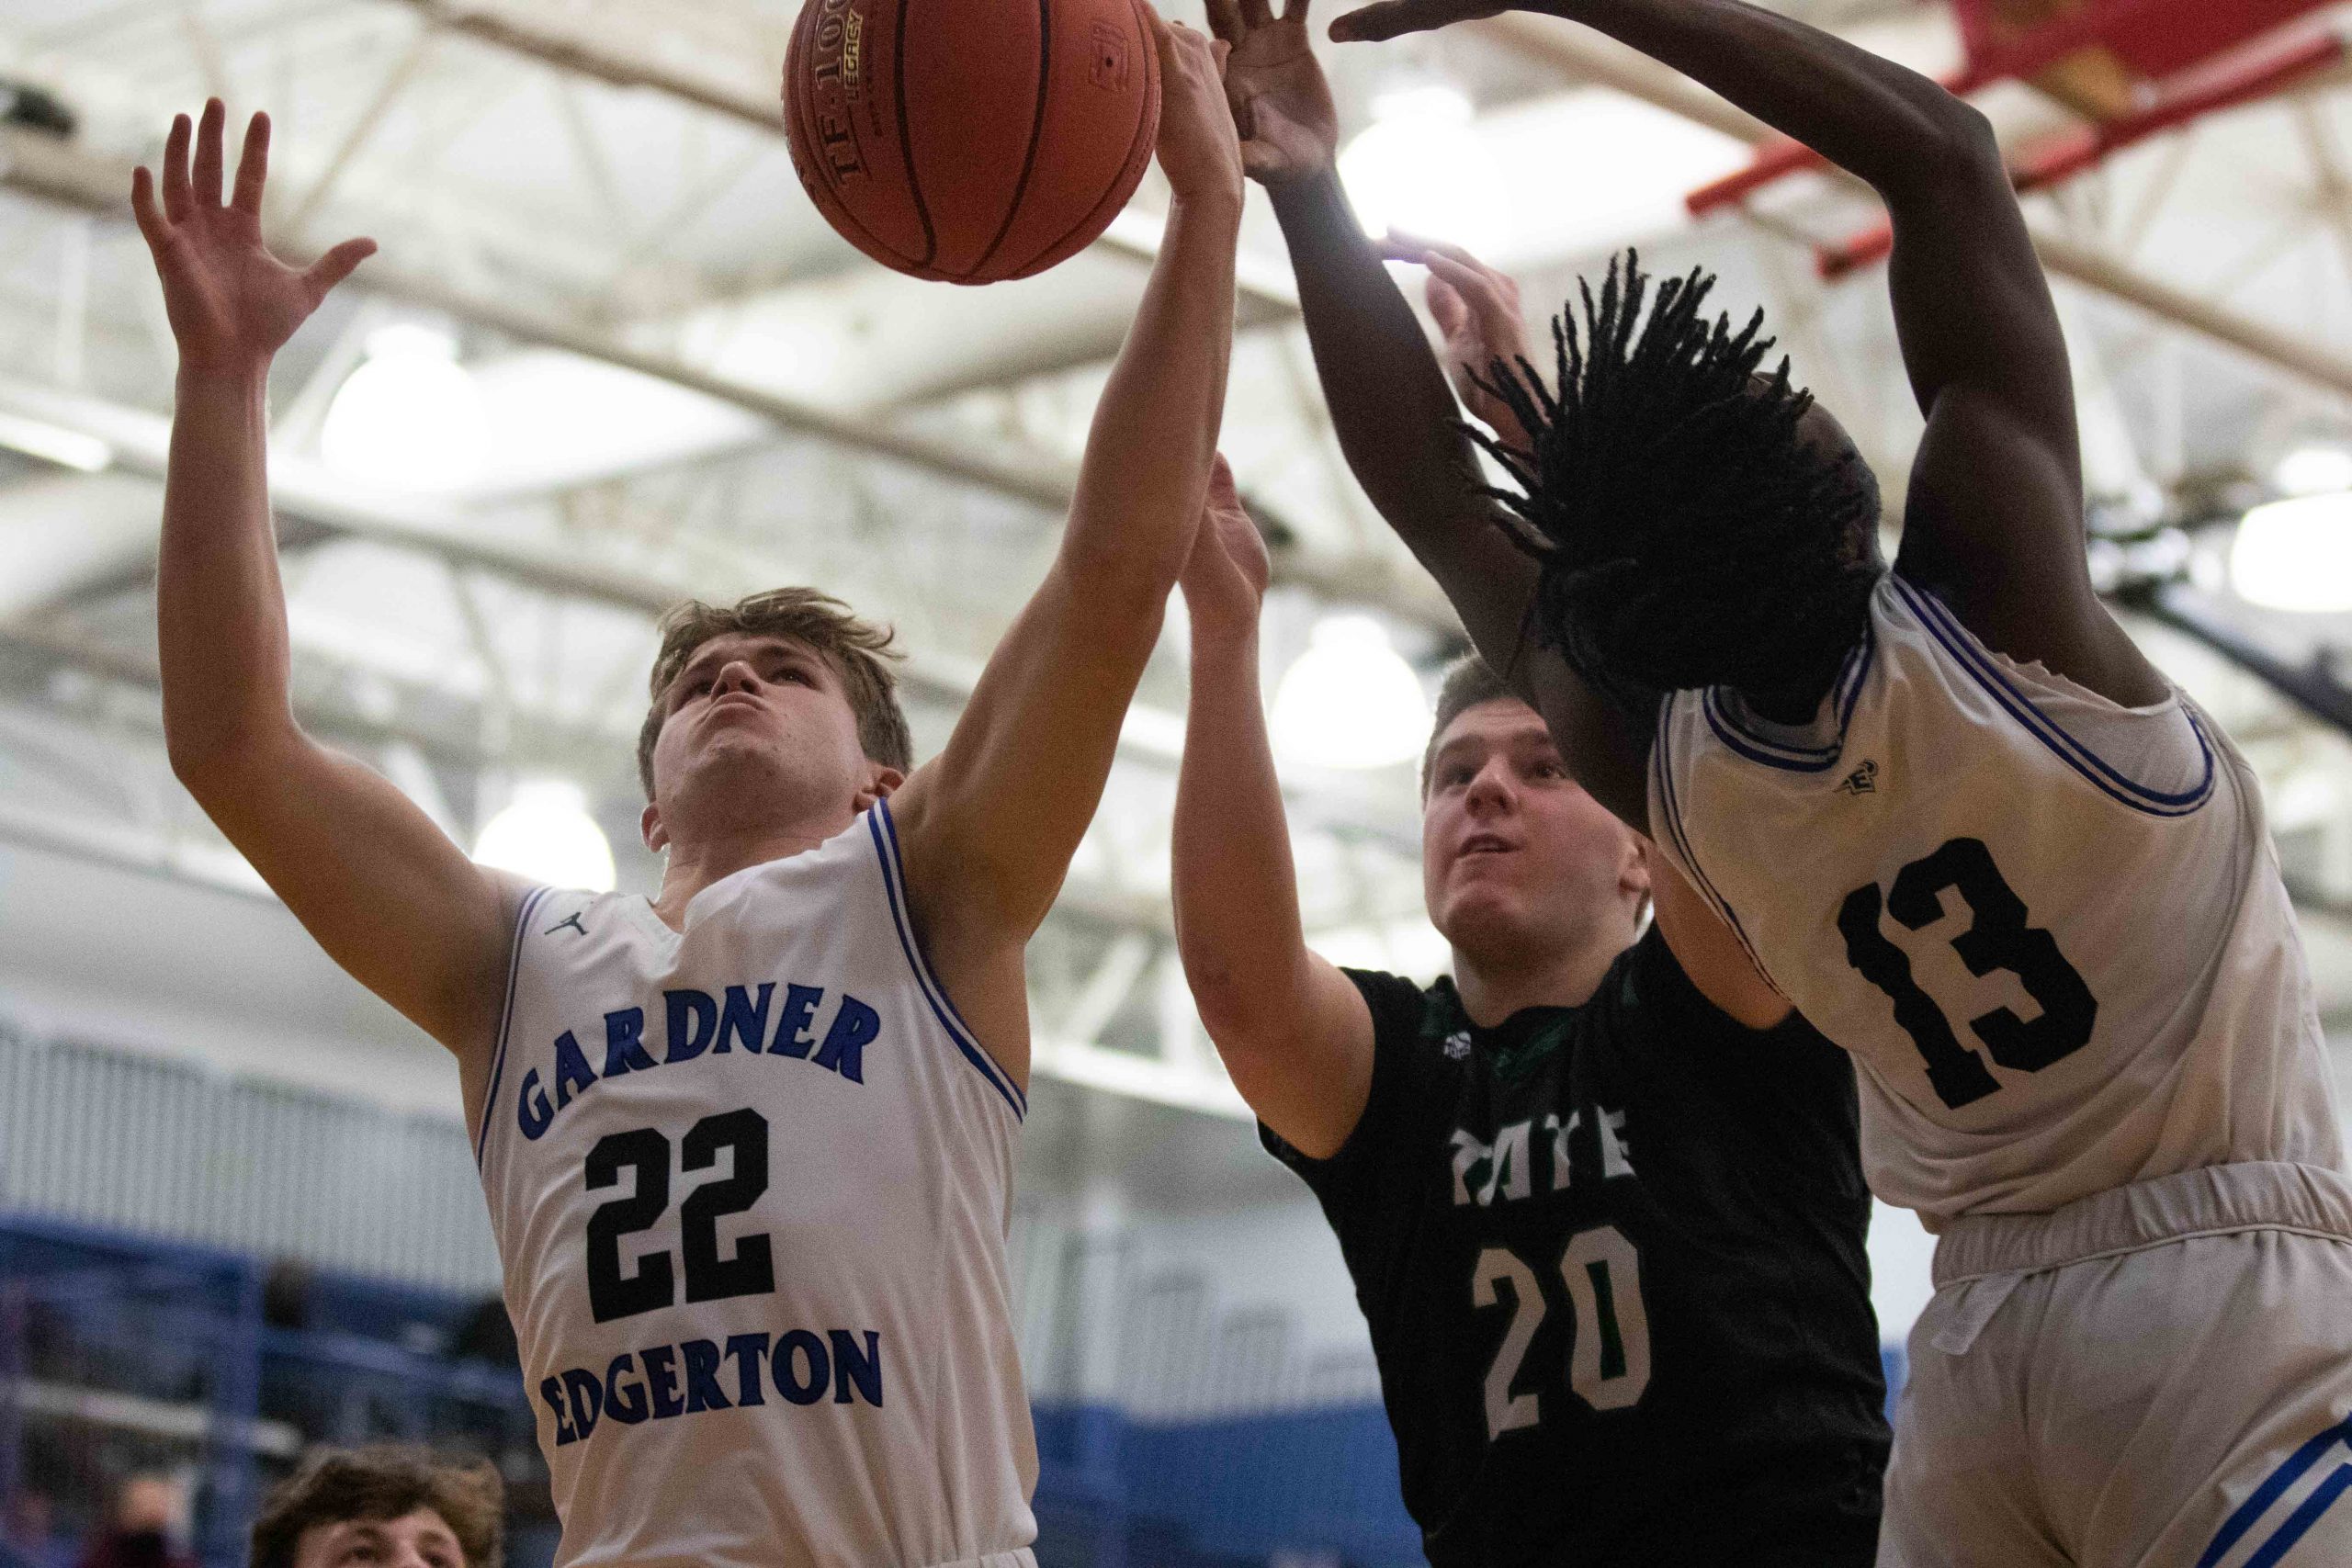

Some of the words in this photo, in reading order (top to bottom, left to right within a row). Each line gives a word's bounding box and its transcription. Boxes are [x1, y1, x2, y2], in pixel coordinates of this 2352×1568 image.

[842, 7, 864, 107] LEGACY
[517, 982, 880, 1140] GARDNER
[1838, 837, 2098, 1110] 13
[585, 1108, 775, 1324] 22
[540, 1329, 883, 1446] EDGERTON
[1473, 1224, 1651, 1442] 20
